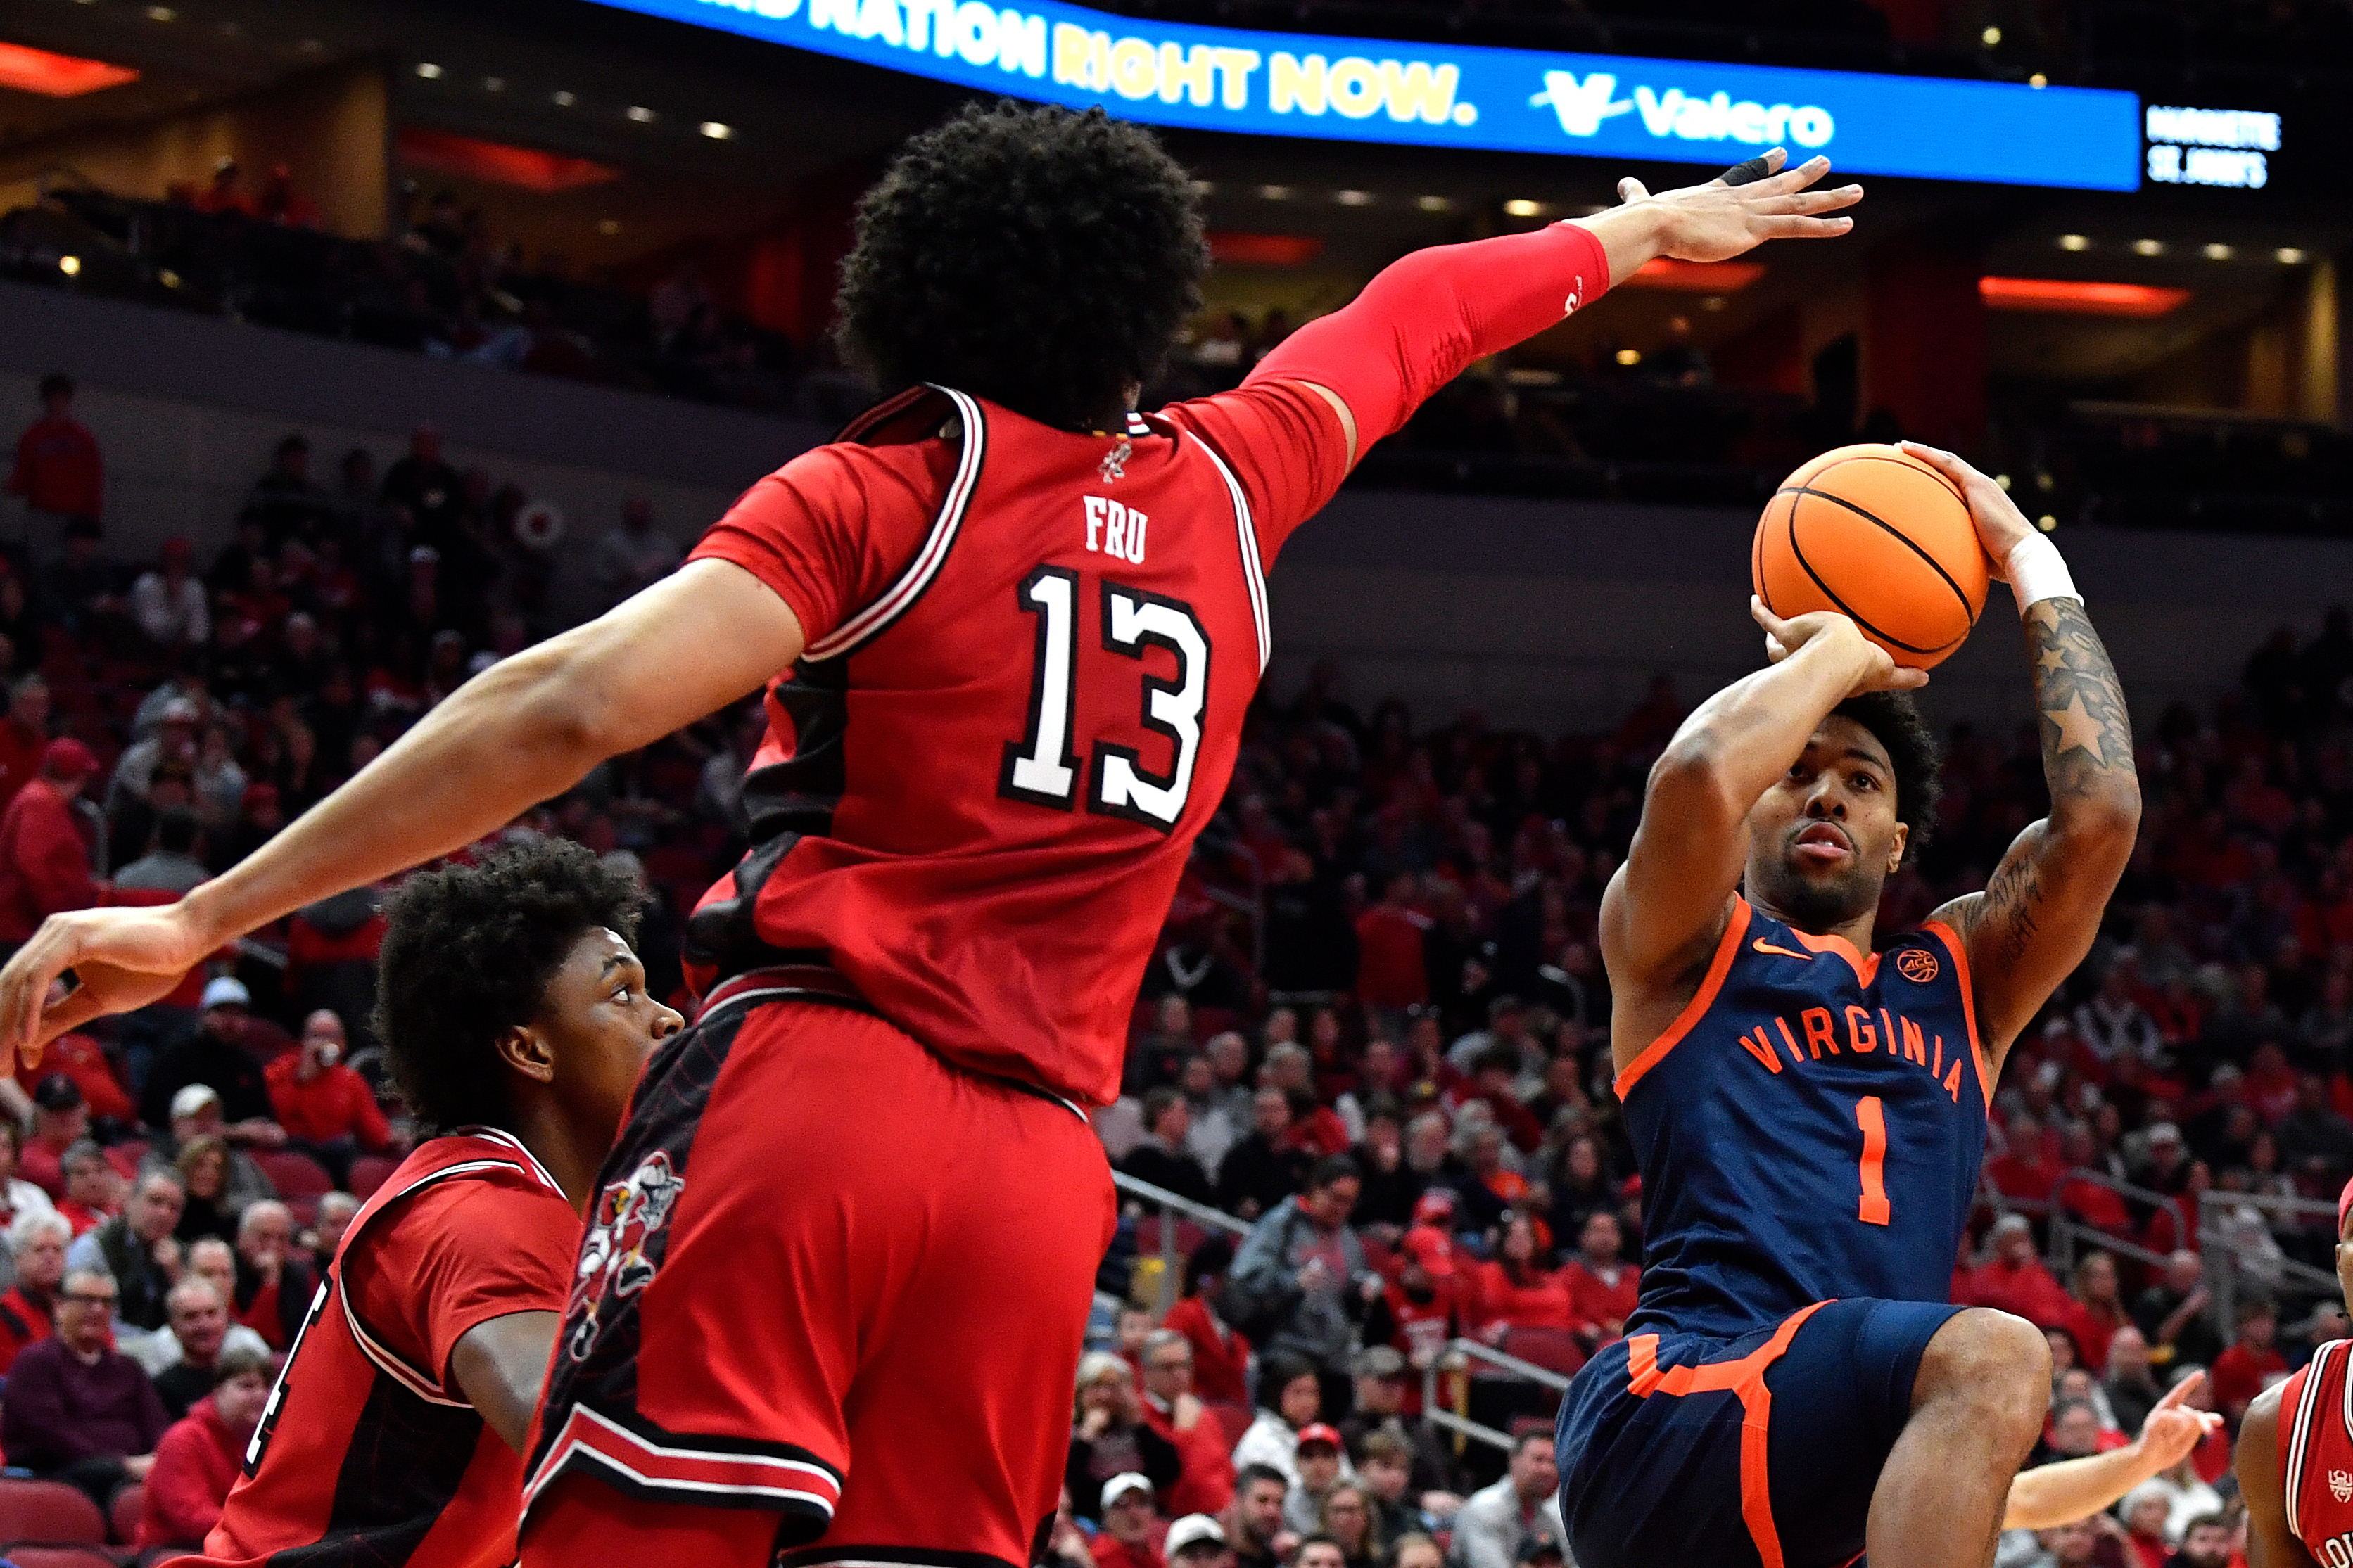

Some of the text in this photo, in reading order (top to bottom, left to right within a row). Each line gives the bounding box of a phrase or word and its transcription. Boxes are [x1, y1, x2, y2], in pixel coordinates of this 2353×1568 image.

[1053, 22, 1261, 110] RIGHT
[1268, 51, 1479, 127] NOW.
[1633, 85, 1836, 148] Valero
[1083, 495, 1148, 564] FRU
[998, 563, 1212, 836] 13
[1738, 1005, 1962, 1104] VIRGINIA
[1856, 1095, 1891, 1226] 1
